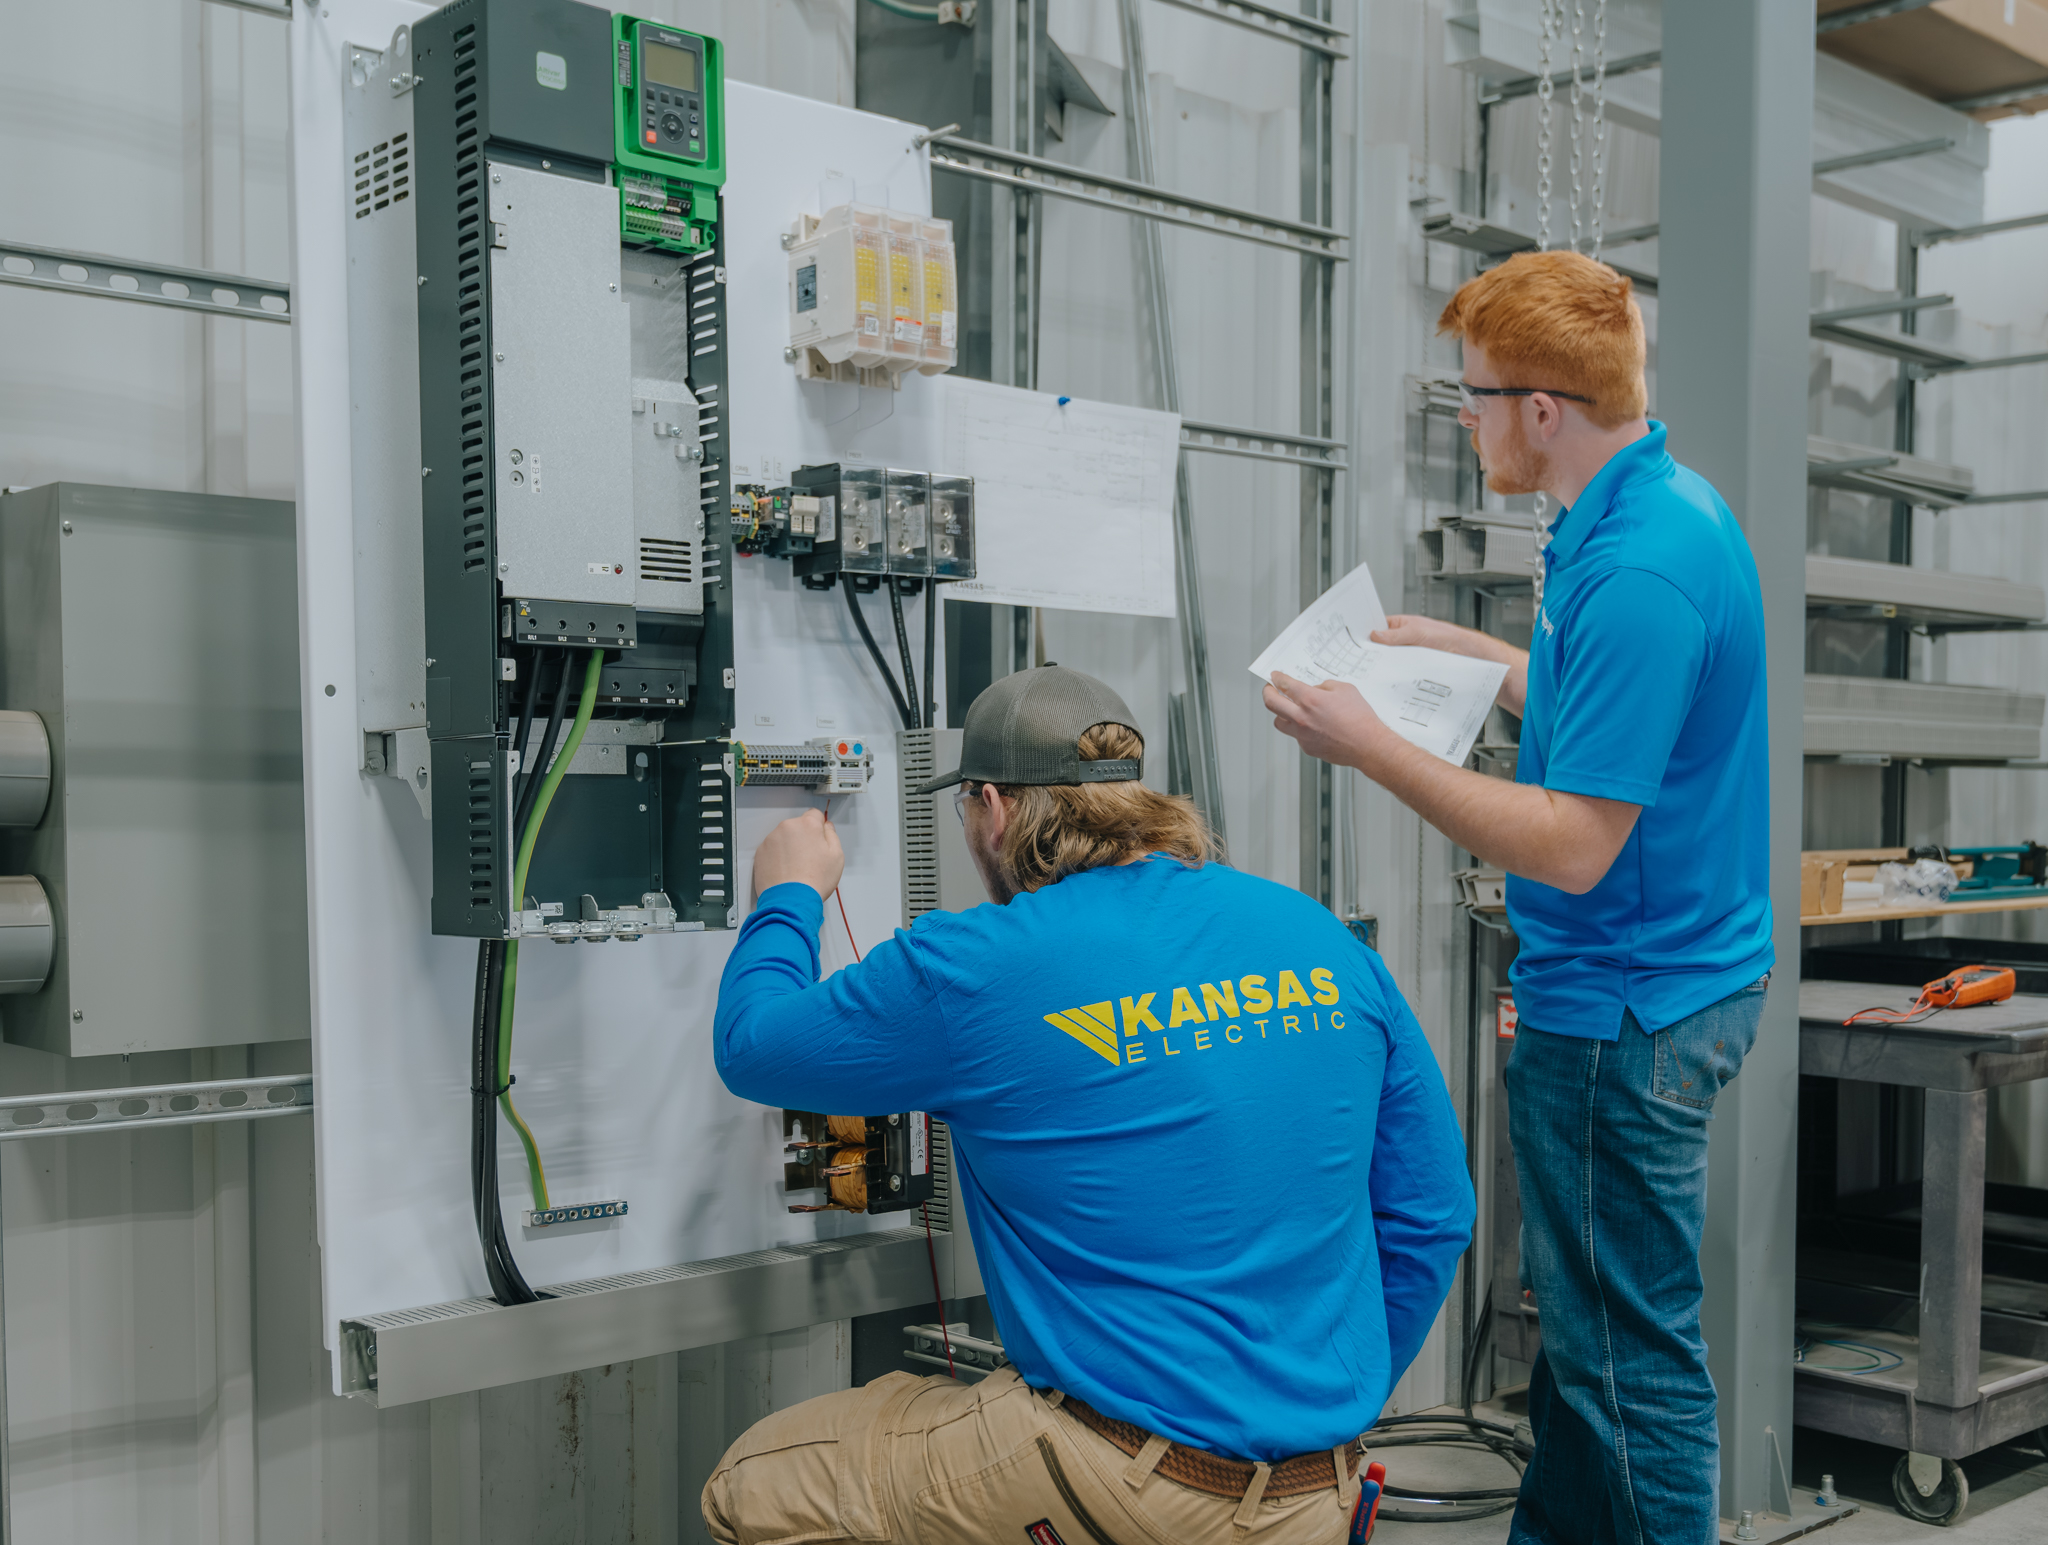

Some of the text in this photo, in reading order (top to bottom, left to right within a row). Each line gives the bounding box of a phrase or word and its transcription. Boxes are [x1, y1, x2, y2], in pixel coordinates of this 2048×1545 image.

[954, 581, 984, 591] KANSAS
[1119, 967, 1340, 1037] KANSAS
[1126, 1011, 1346, 1064] ELECTRIC
[1356, 1501, 1370, 1536] KNIPEX
